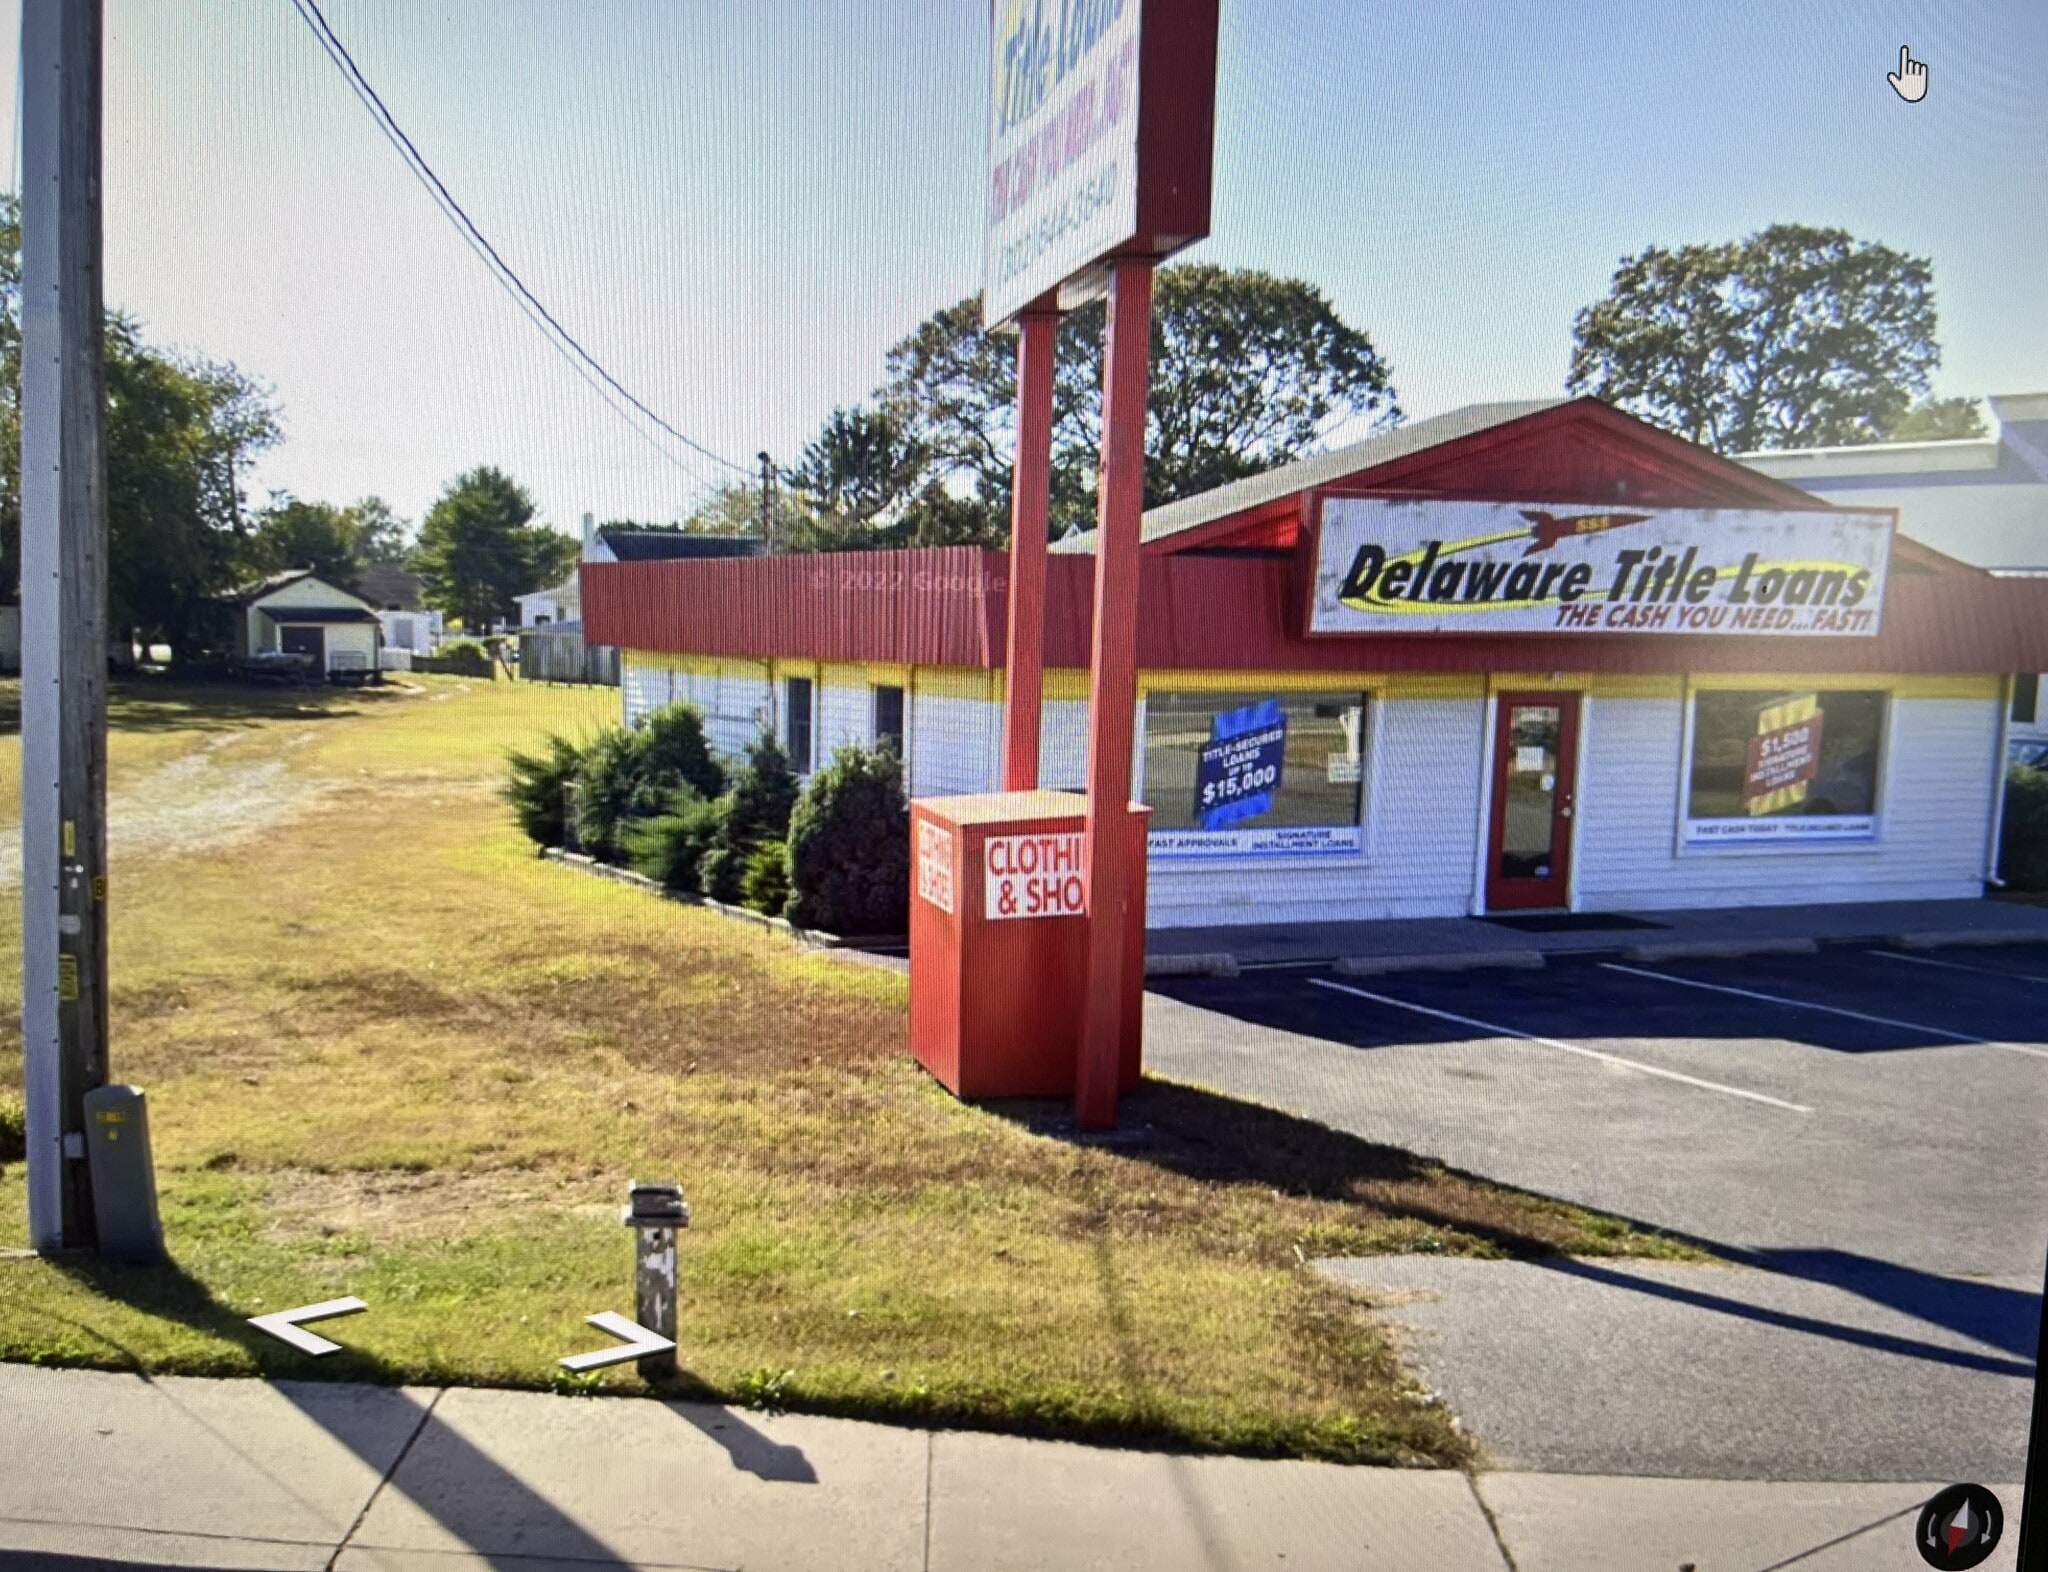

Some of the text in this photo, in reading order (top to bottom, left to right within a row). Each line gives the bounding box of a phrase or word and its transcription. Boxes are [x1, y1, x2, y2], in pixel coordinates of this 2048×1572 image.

[1339, 541, 1870, 607] Delaware Title Loans
[1555, 604, 1603, 629] THE
[1605, 605, 1673, 629] CASH
[1679, 605, 1729, 629] YOU
[1203, 764, 1276, 804] $15,000
[988, 838, 1080, 876] CLOTHI
[1177, 838, 1237, 848] APPROVALS
[998, 876, 1084, 915] & SHO
